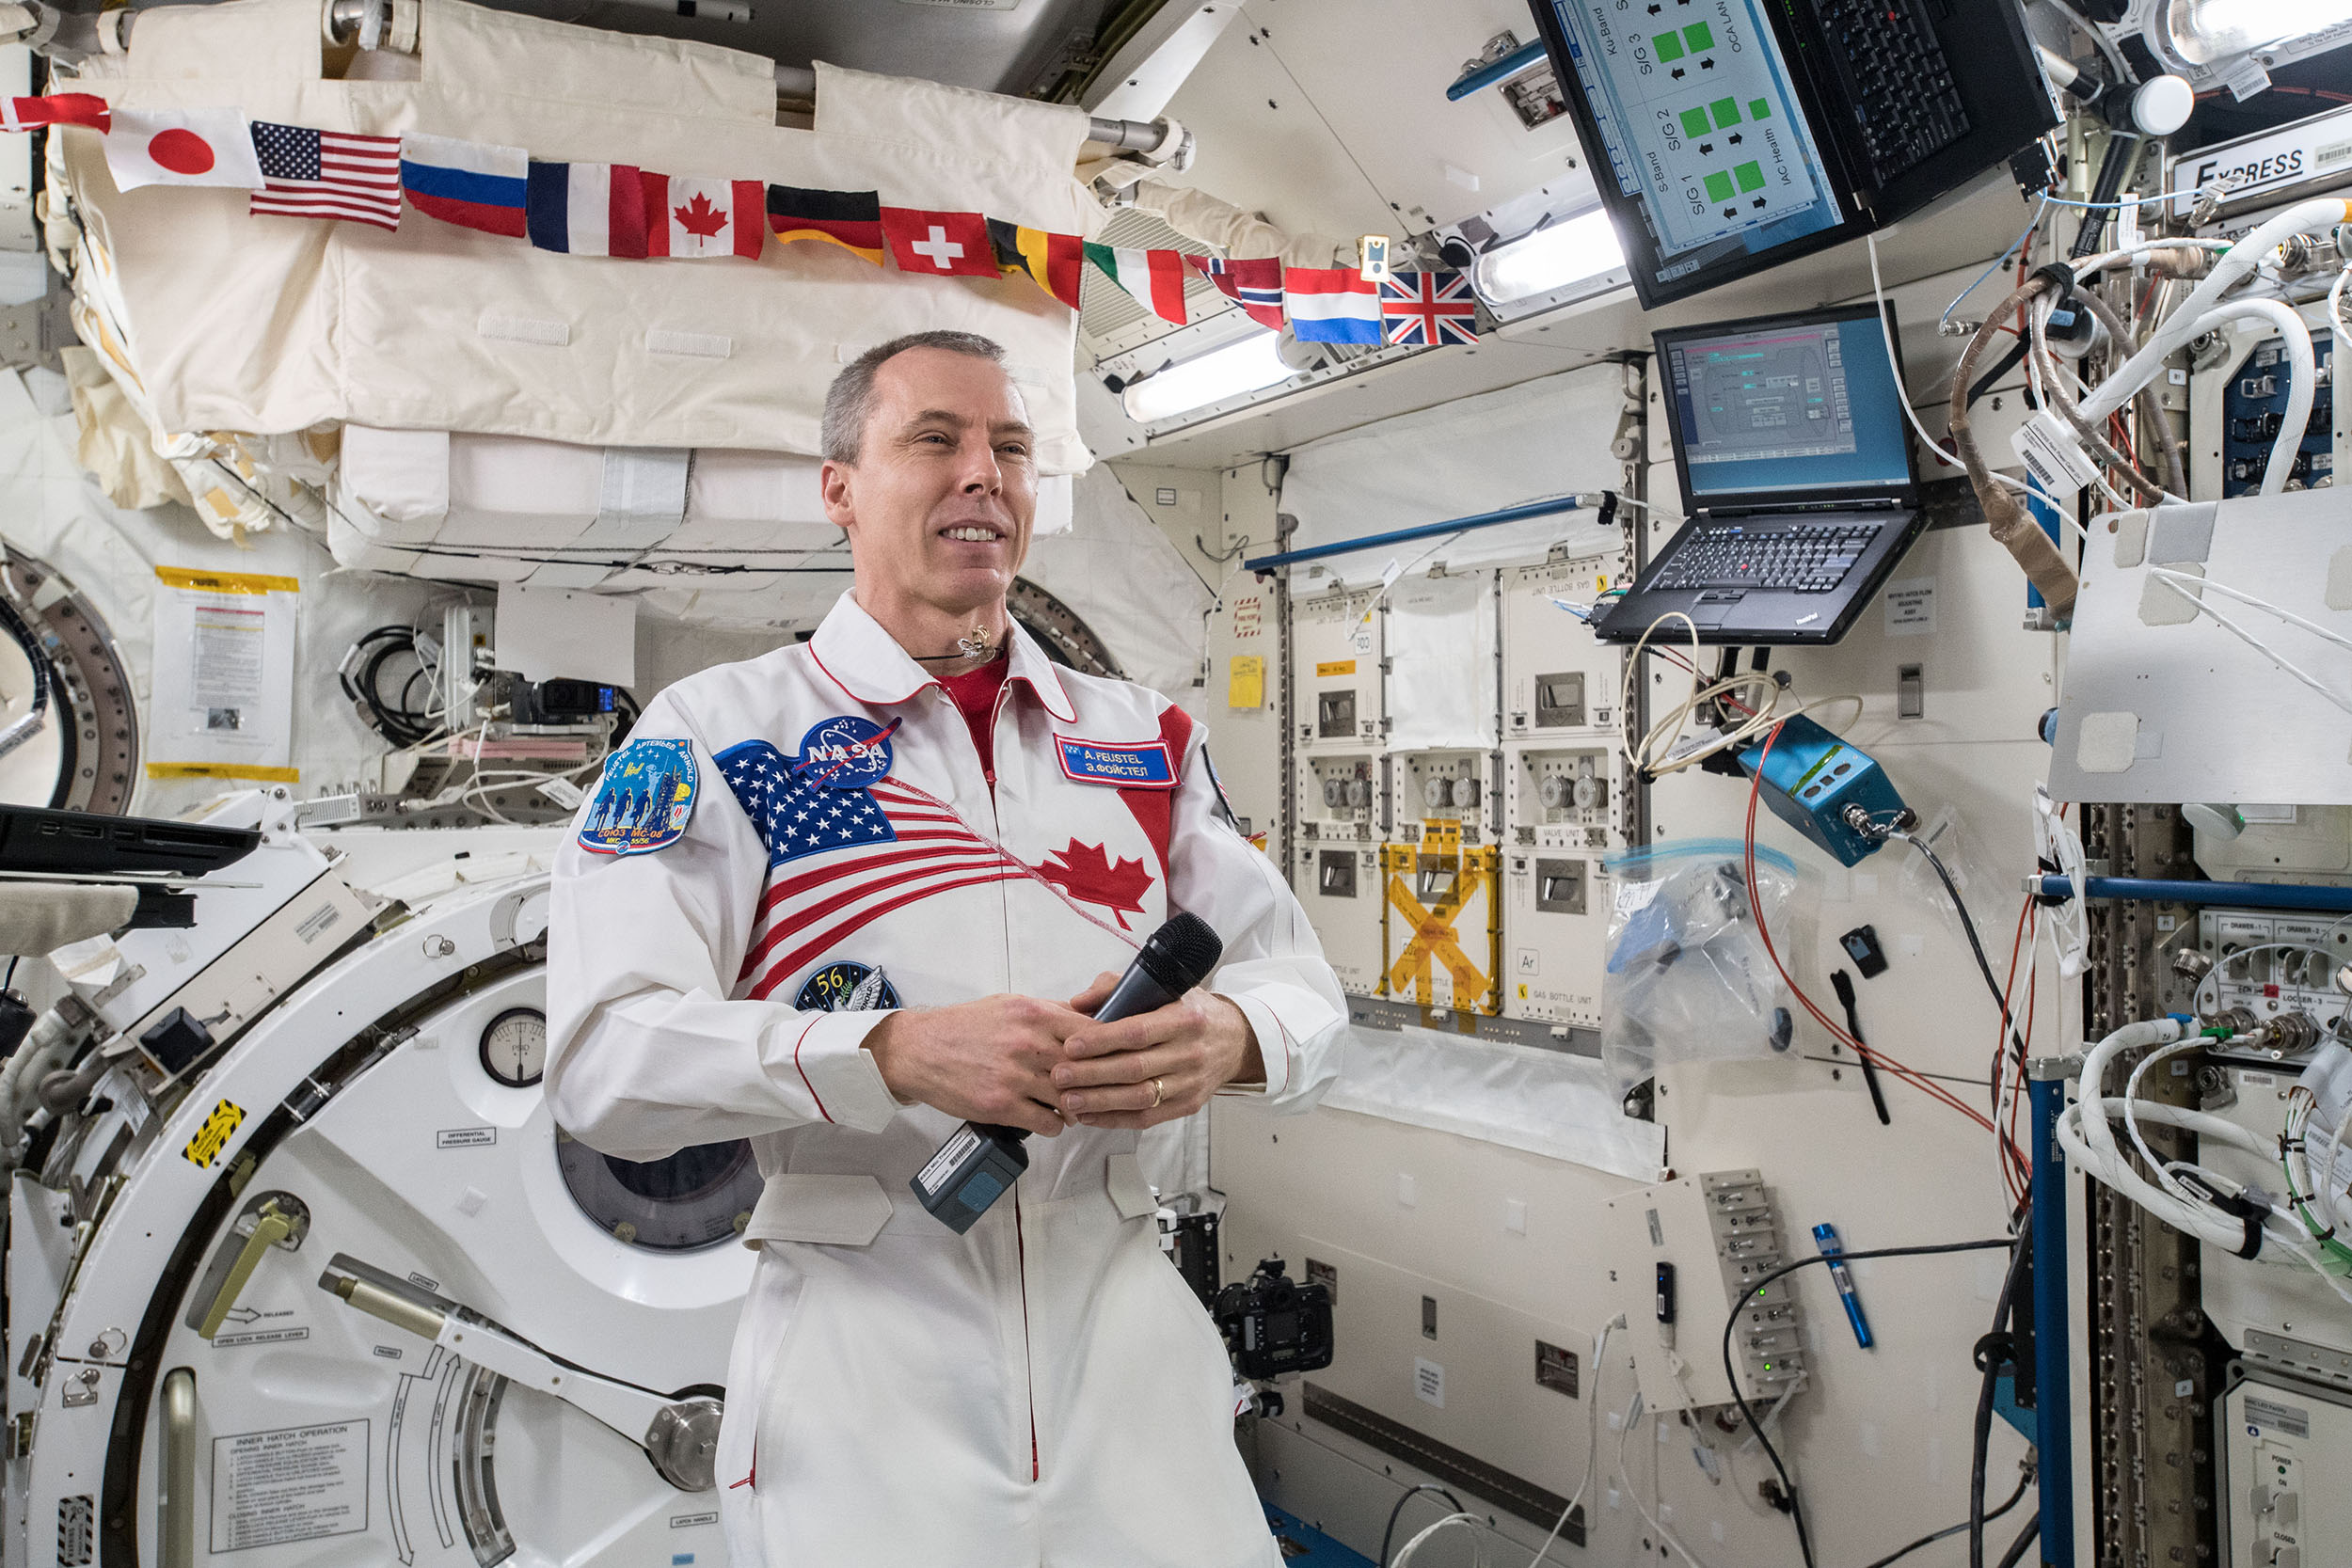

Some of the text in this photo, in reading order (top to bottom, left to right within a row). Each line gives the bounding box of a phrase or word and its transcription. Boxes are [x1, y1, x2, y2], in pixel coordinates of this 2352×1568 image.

[1594, 8, 1618, 55] Ku-Band
[1716, 1, 1741, 53] OCA LAN
[1629, 33, 1653, 75] S/G 3
[1657, 108, 1681, 151] S/G 2
[1764, 128, 1784, 164] Health
[1646, 151, 1669, 193] S-Band
[1680, 174, 1706, 215] S/G 1
[2032, 423, 2050, 443] EXPRESS
[2049, 442, 2058, 451] Rack
[2057, 451, 2067, 463] Power
[2065, 461, 2076, 473] Cable
[1532, 587, 1546, 597] UNIT
[1577, 580, 1591, 590] GAS
[807, 742, 888, 764] NASA
[605, 750, 631, 782] FEUSTEL
[677, 751, 694, 783] ARNOLD
[1544, 829, 1581, 837] VALVE UNIT
[2230, 922, 2253, 930] DRAWER
[2286, 926, 2311, 934] DRAWER
[1521, 955, 1534, 969] Ar
[816, 966, 844, 996] 56
[860, 986, 873, 1011] RNOLD
[1533, 990, 1593, 1005] GAS BOTTLE UNIT
[2282, 995, 2312, 1004] LOCER
[447, 1131, 486, 1139] DIFFERENTIAL
[939, 1133, 963, 1161] Transmitter
[412, 1275, 436, 1289] LATCHED
[255, 1333, 282, 1341] RELEASE
[236, 1425, 348, 1447] INNER HATCH OPERATION
[230, 1445, 260, 1455] OPENING
[262, 1443, 283, 1451] INNER
[2271, 1454, 2293, 1466] POWER
[2278, 1478, 2287, 1487] ON
[2273, 1531, 2296, 1544] CLOSED
